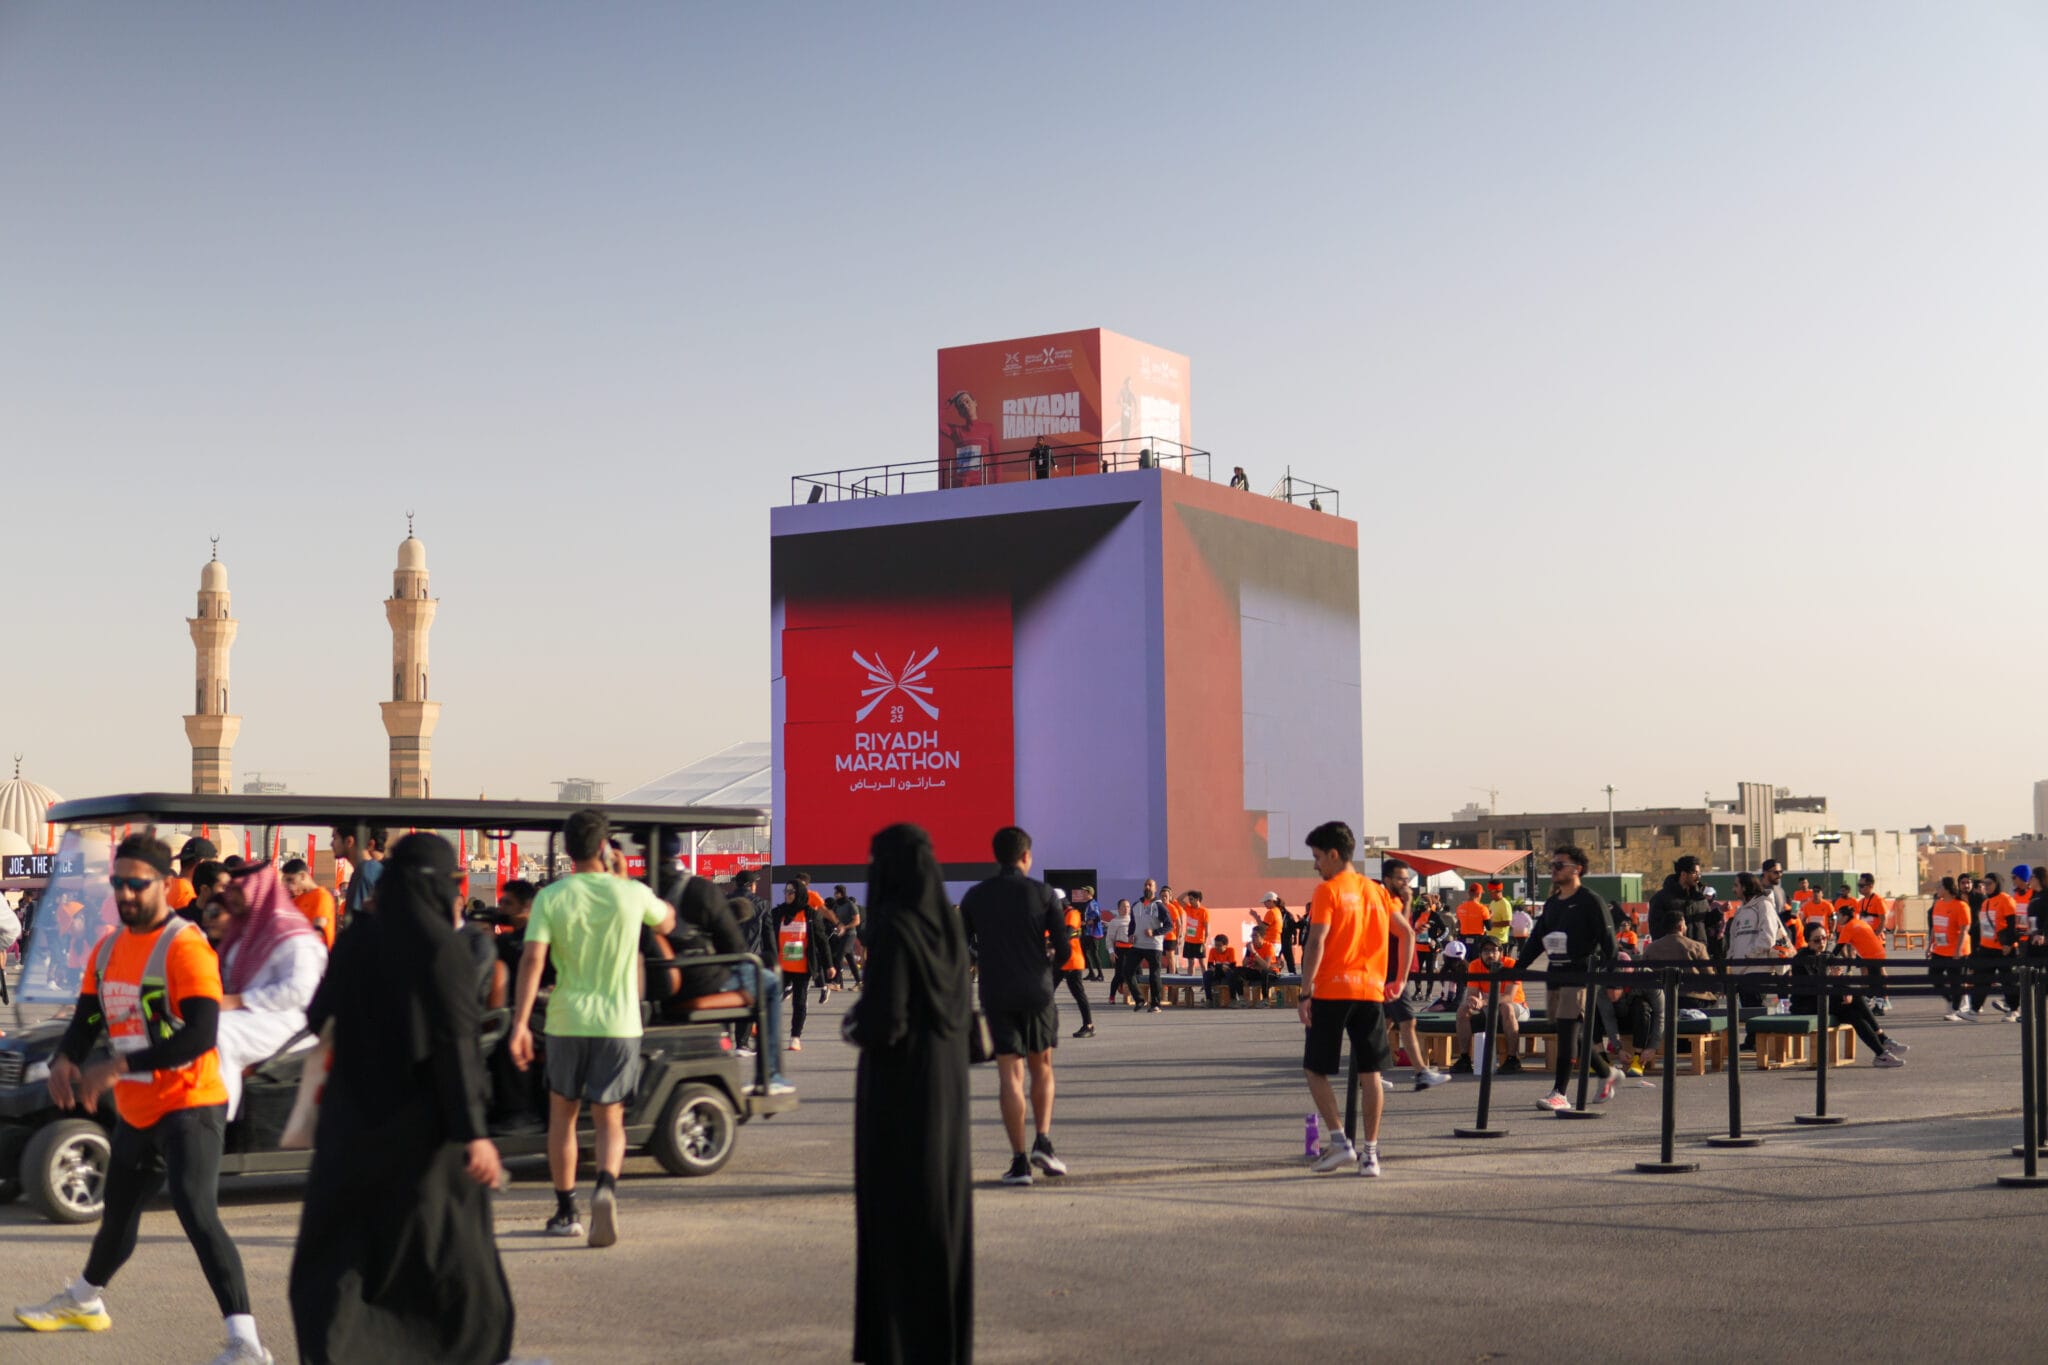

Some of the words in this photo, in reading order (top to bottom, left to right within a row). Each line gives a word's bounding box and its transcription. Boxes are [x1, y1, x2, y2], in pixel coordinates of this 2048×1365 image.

[1003, 391, 1080, 416] RIYADH
[1003, 416, 1080, 439] MARATHON
[890, 706, 904, 714] 20
[890, 715, 904, 723] 25
[855, 730, 938, 751] RIYADH
[835, 751, 960, 772] MARATHON
[850, 777, 896, 792] الرياض
[898, 776, 946, 790] ماراثون
[9, 856, 24, 875] JOE
[31, 856, 48, 874] THE
